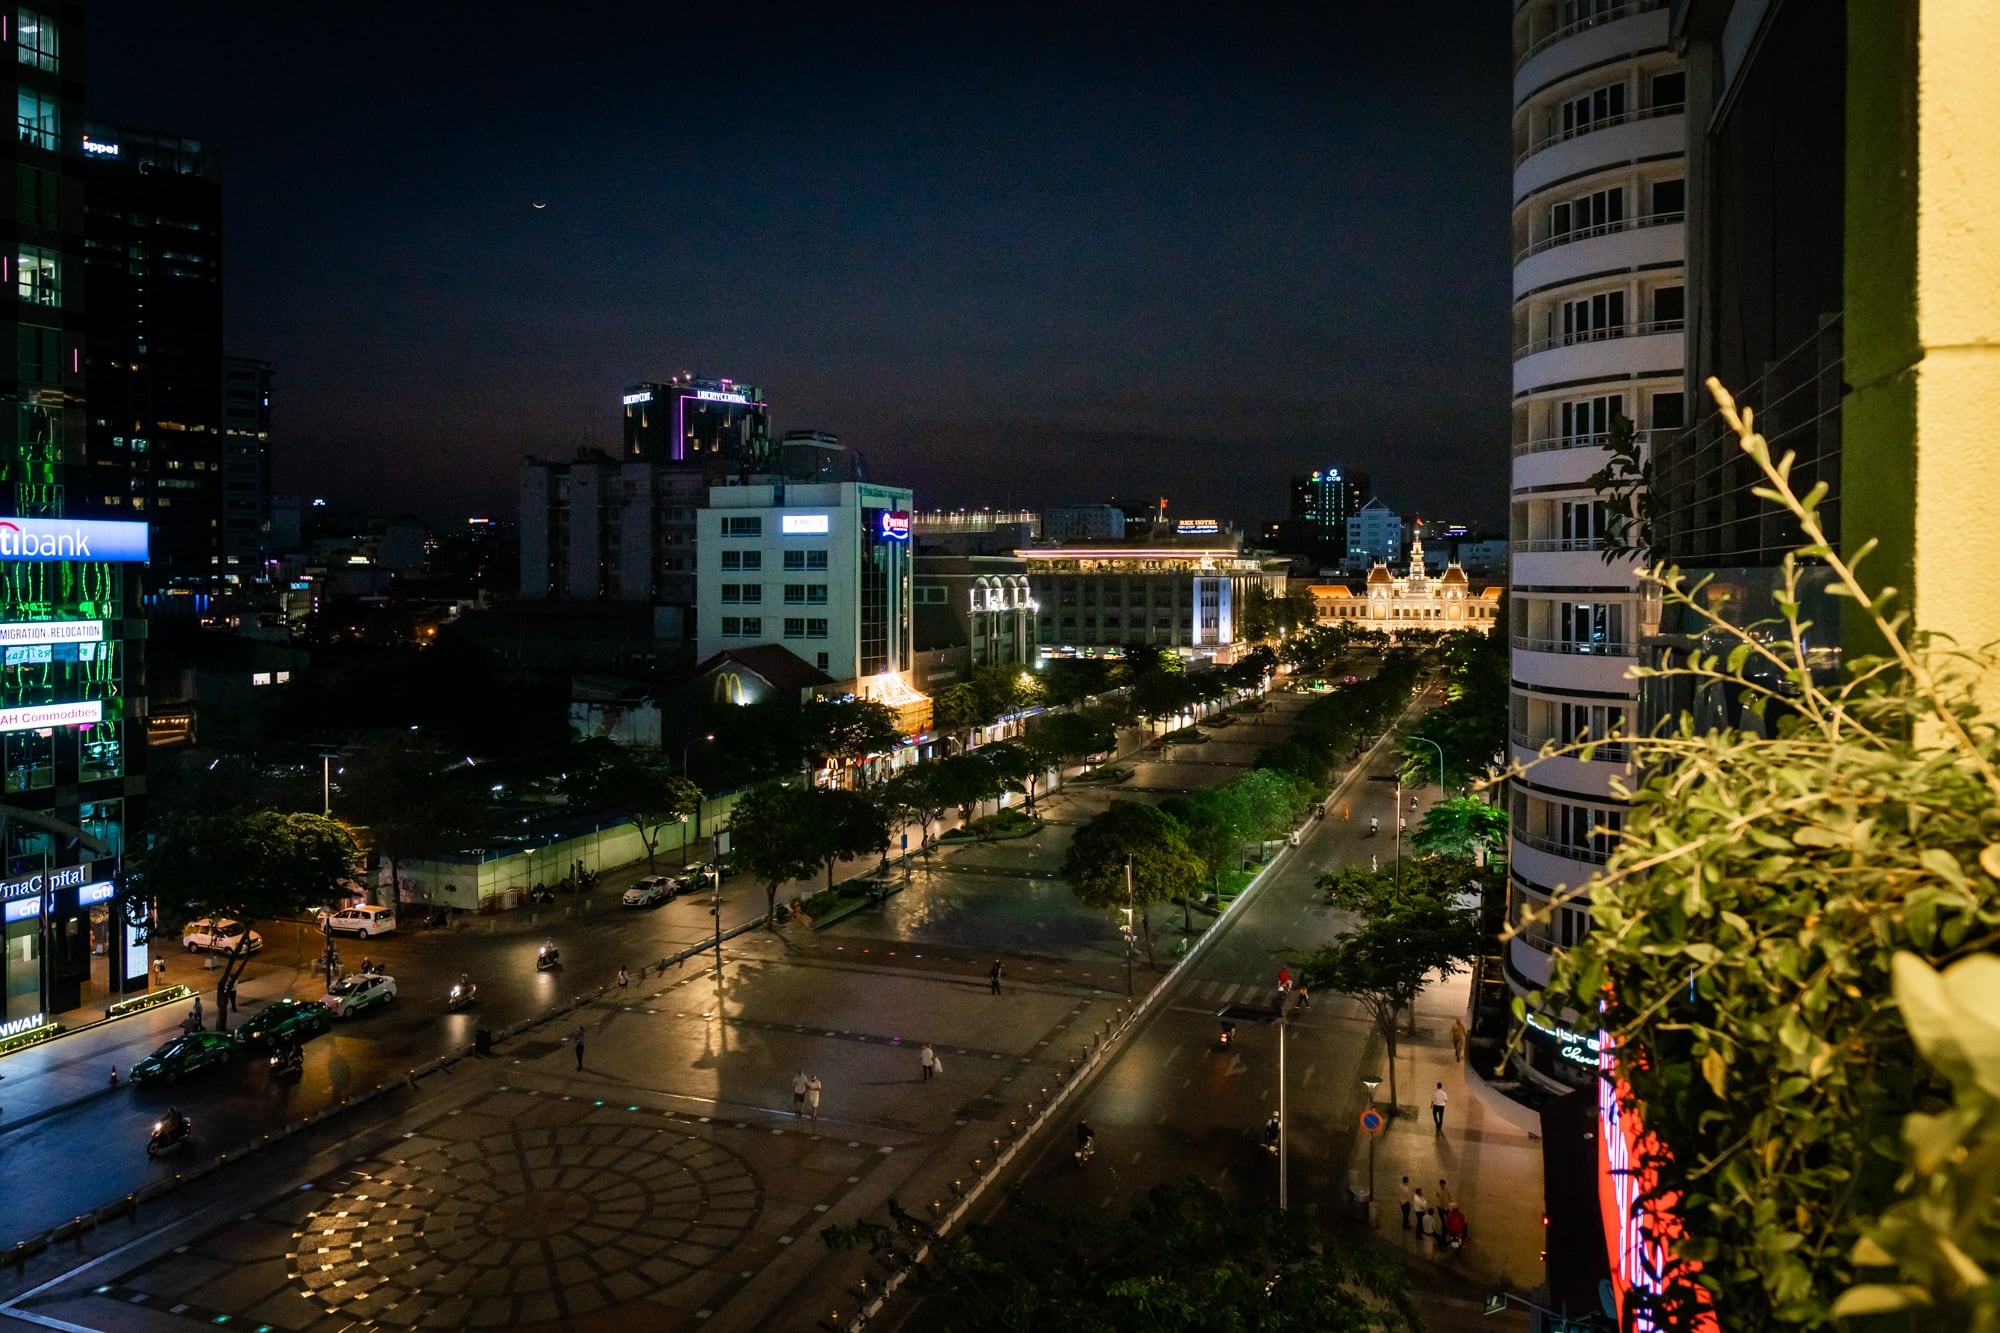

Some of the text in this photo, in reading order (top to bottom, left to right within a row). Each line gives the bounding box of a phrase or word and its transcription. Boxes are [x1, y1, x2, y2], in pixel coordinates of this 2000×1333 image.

[51, 625, 100, 638] RELOCATION
[22, 708, 97, 723] Commodities
[0, 865, 86, 898] inaCpital
